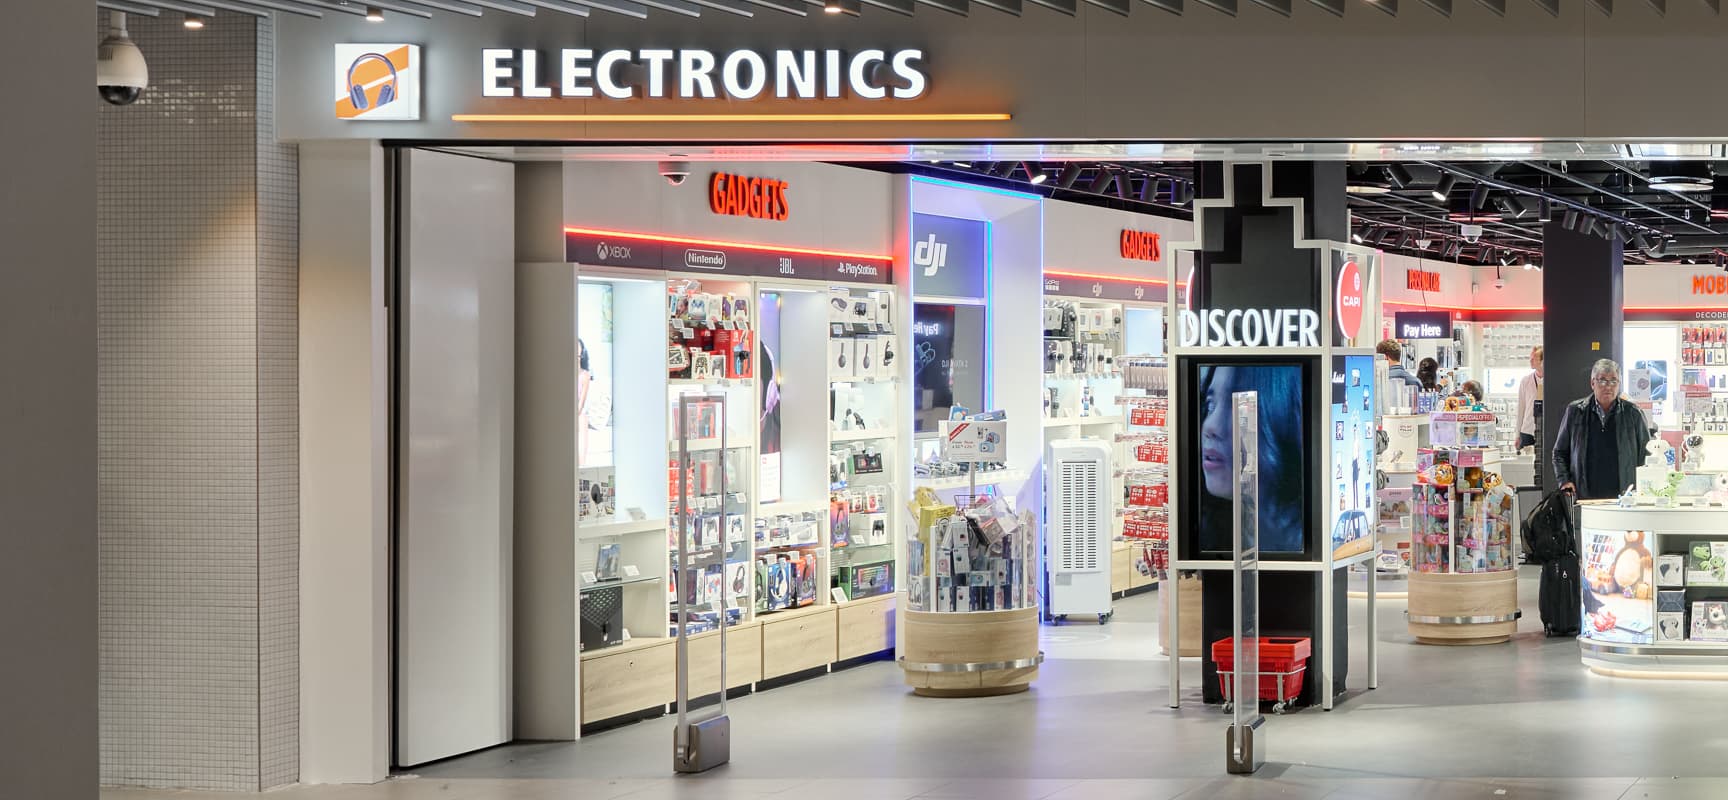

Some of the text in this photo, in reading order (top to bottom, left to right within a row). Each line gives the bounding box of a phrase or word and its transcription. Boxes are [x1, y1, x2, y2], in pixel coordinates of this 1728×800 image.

[482, 48, 926, 99] ELECTRONICS
[712, 172, 789, 222] GADGETS
[609, 246, 631, 259] XBOX
[1121, 229, 1160, 262] GADGETS
[688, 252, 724, 265] Nintendo
[779, 257, 794, 275] JBL
[845, 263, 877, 277] PlayStation
[1343, 296, 1361, 307] CAPI
[1180, 308, 1320, 348] DISCOVER
[1403, 323, 1441, 338] Pay Here
